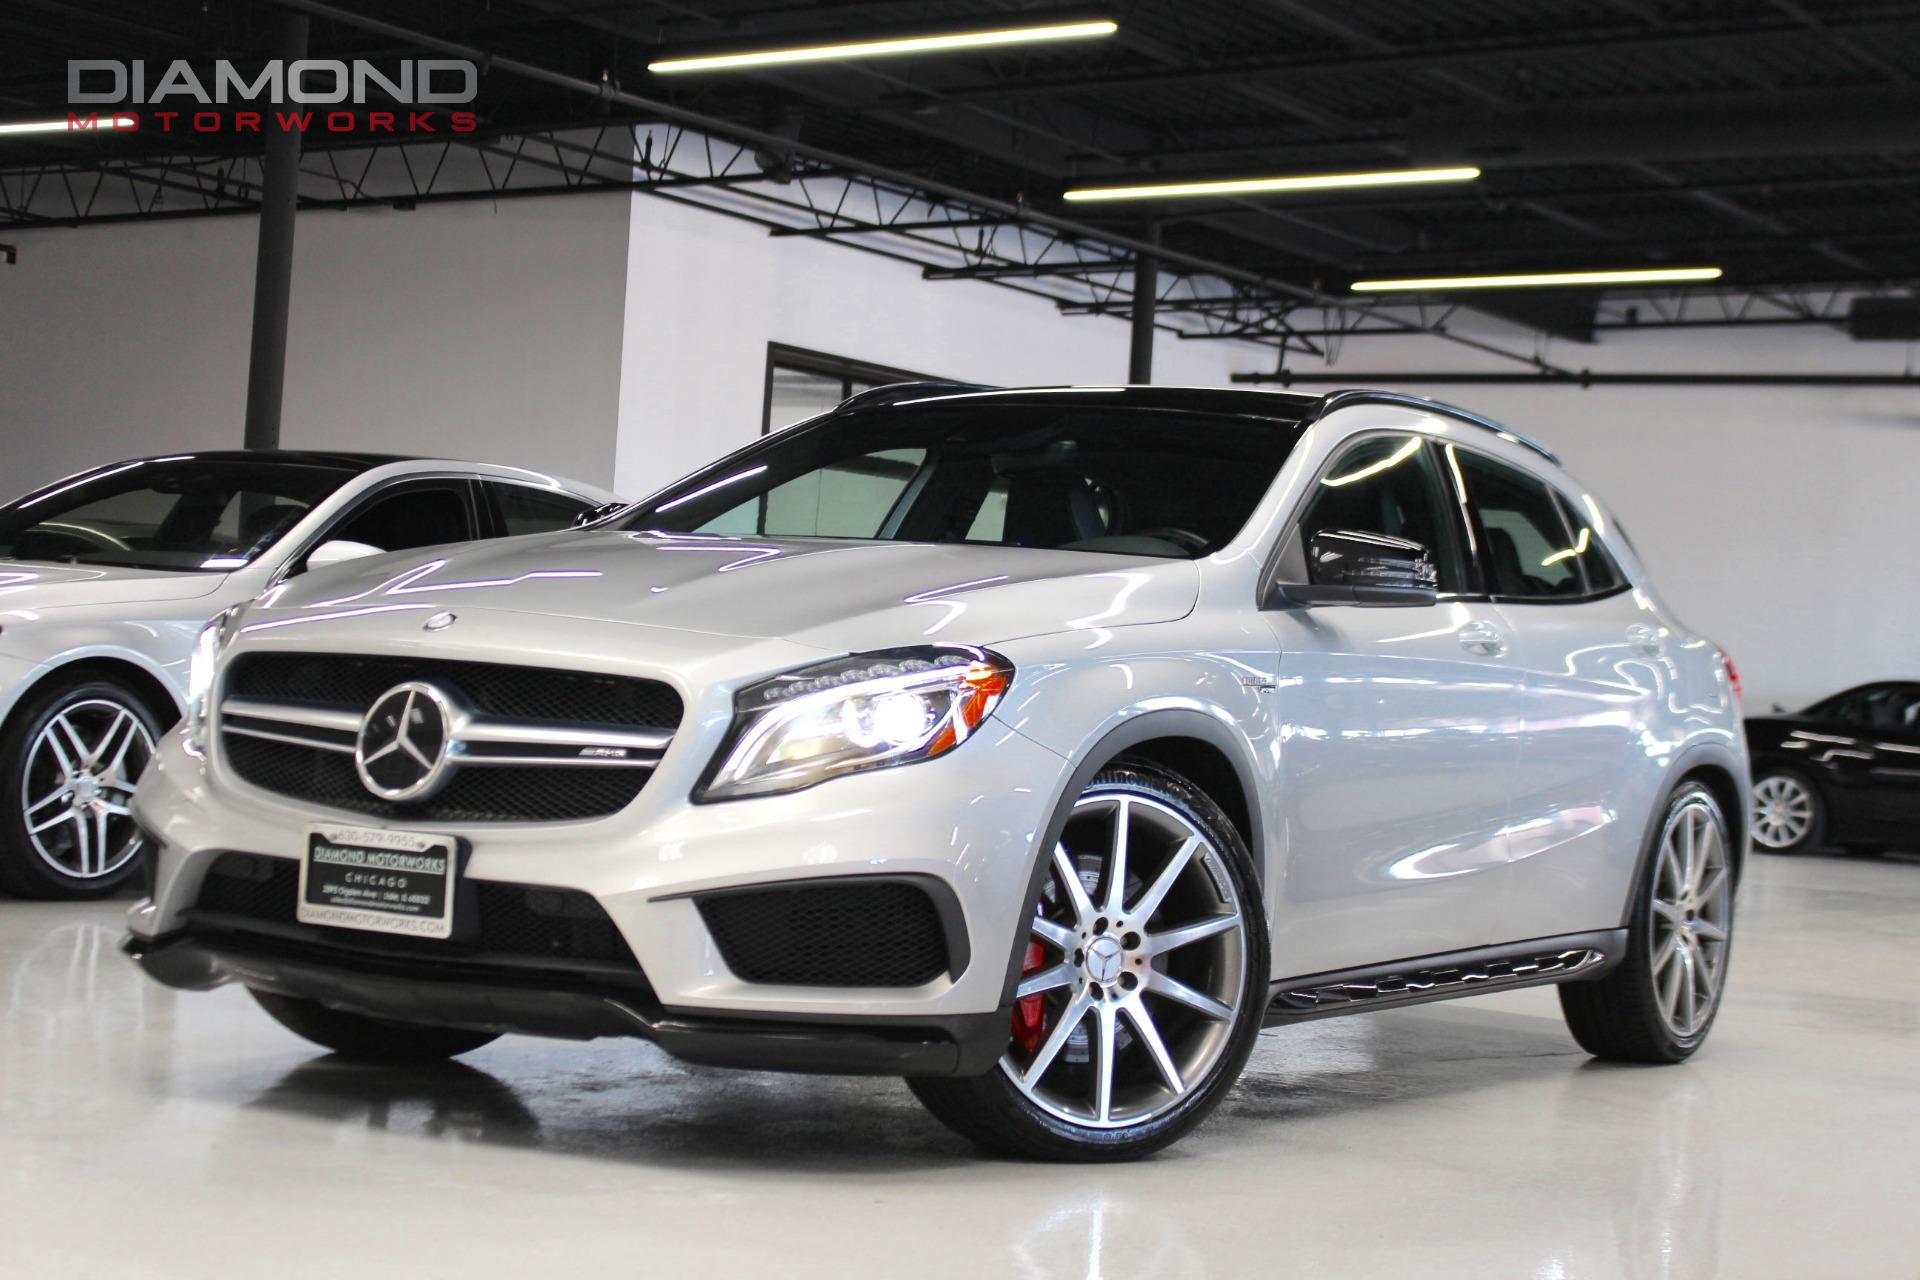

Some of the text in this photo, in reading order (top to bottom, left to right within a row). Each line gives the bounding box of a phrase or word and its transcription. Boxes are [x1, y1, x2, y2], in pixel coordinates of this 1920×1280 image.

[313, 846, 446, 872] DIAMOND MOTORWORKS
[344, 872, 408, 889] CHICAGO
